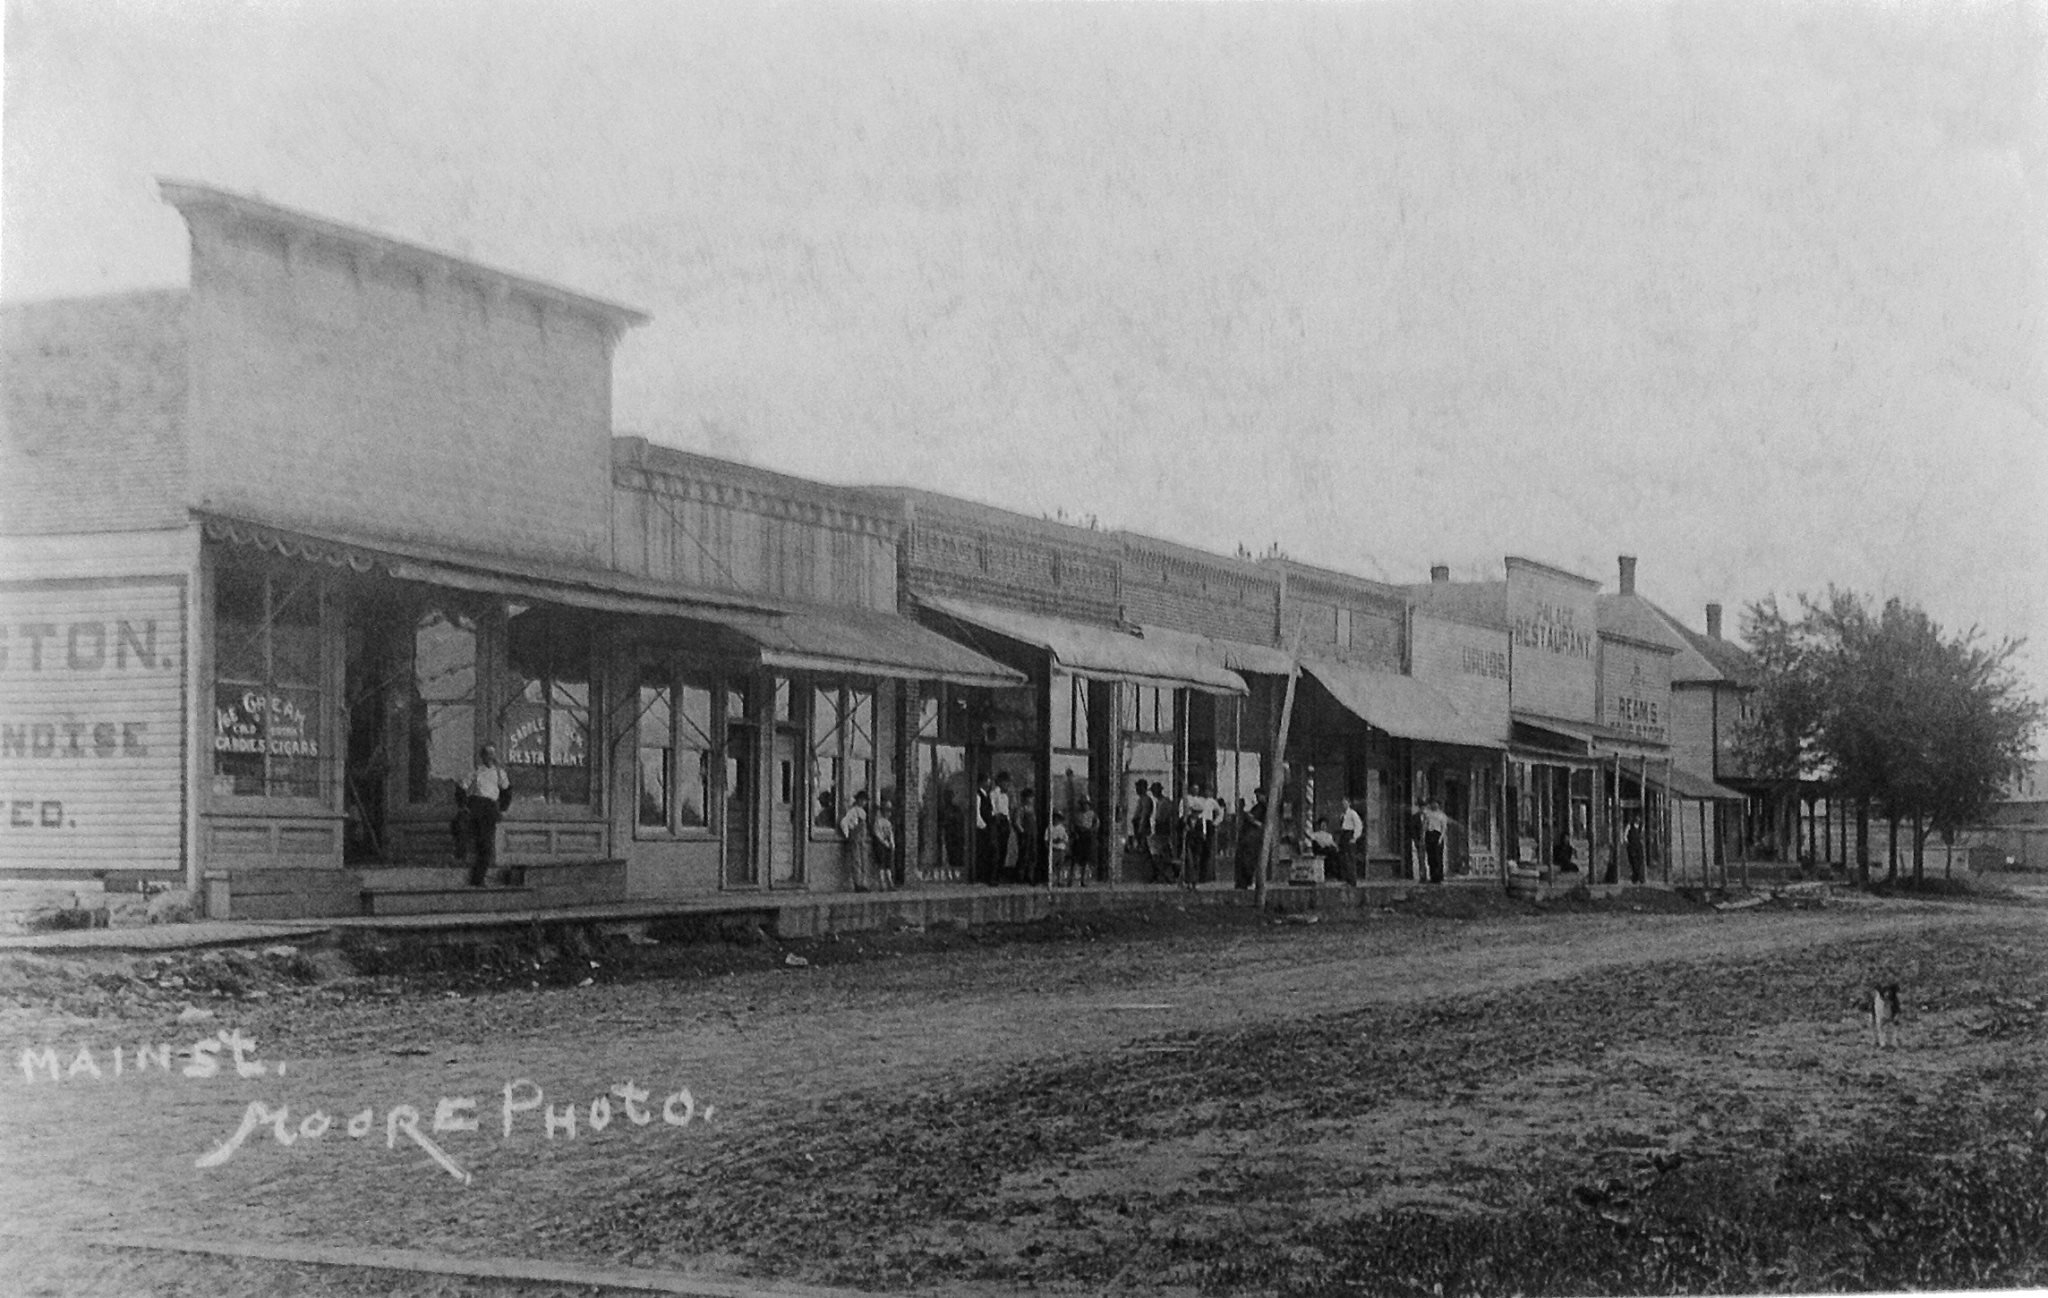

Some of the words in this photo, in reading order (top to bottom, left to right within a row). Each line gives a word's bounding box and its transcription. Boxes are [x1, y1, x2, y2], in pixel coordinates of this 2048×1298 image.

[0, 619, 173, 672] TON.
[1514, 616, 1592, 661] RESTAURANT
[242, 691, 306, 737] CREAM
[270, 740, 319, 757] CIGARS
[0, 800, 77, 829] ED.
